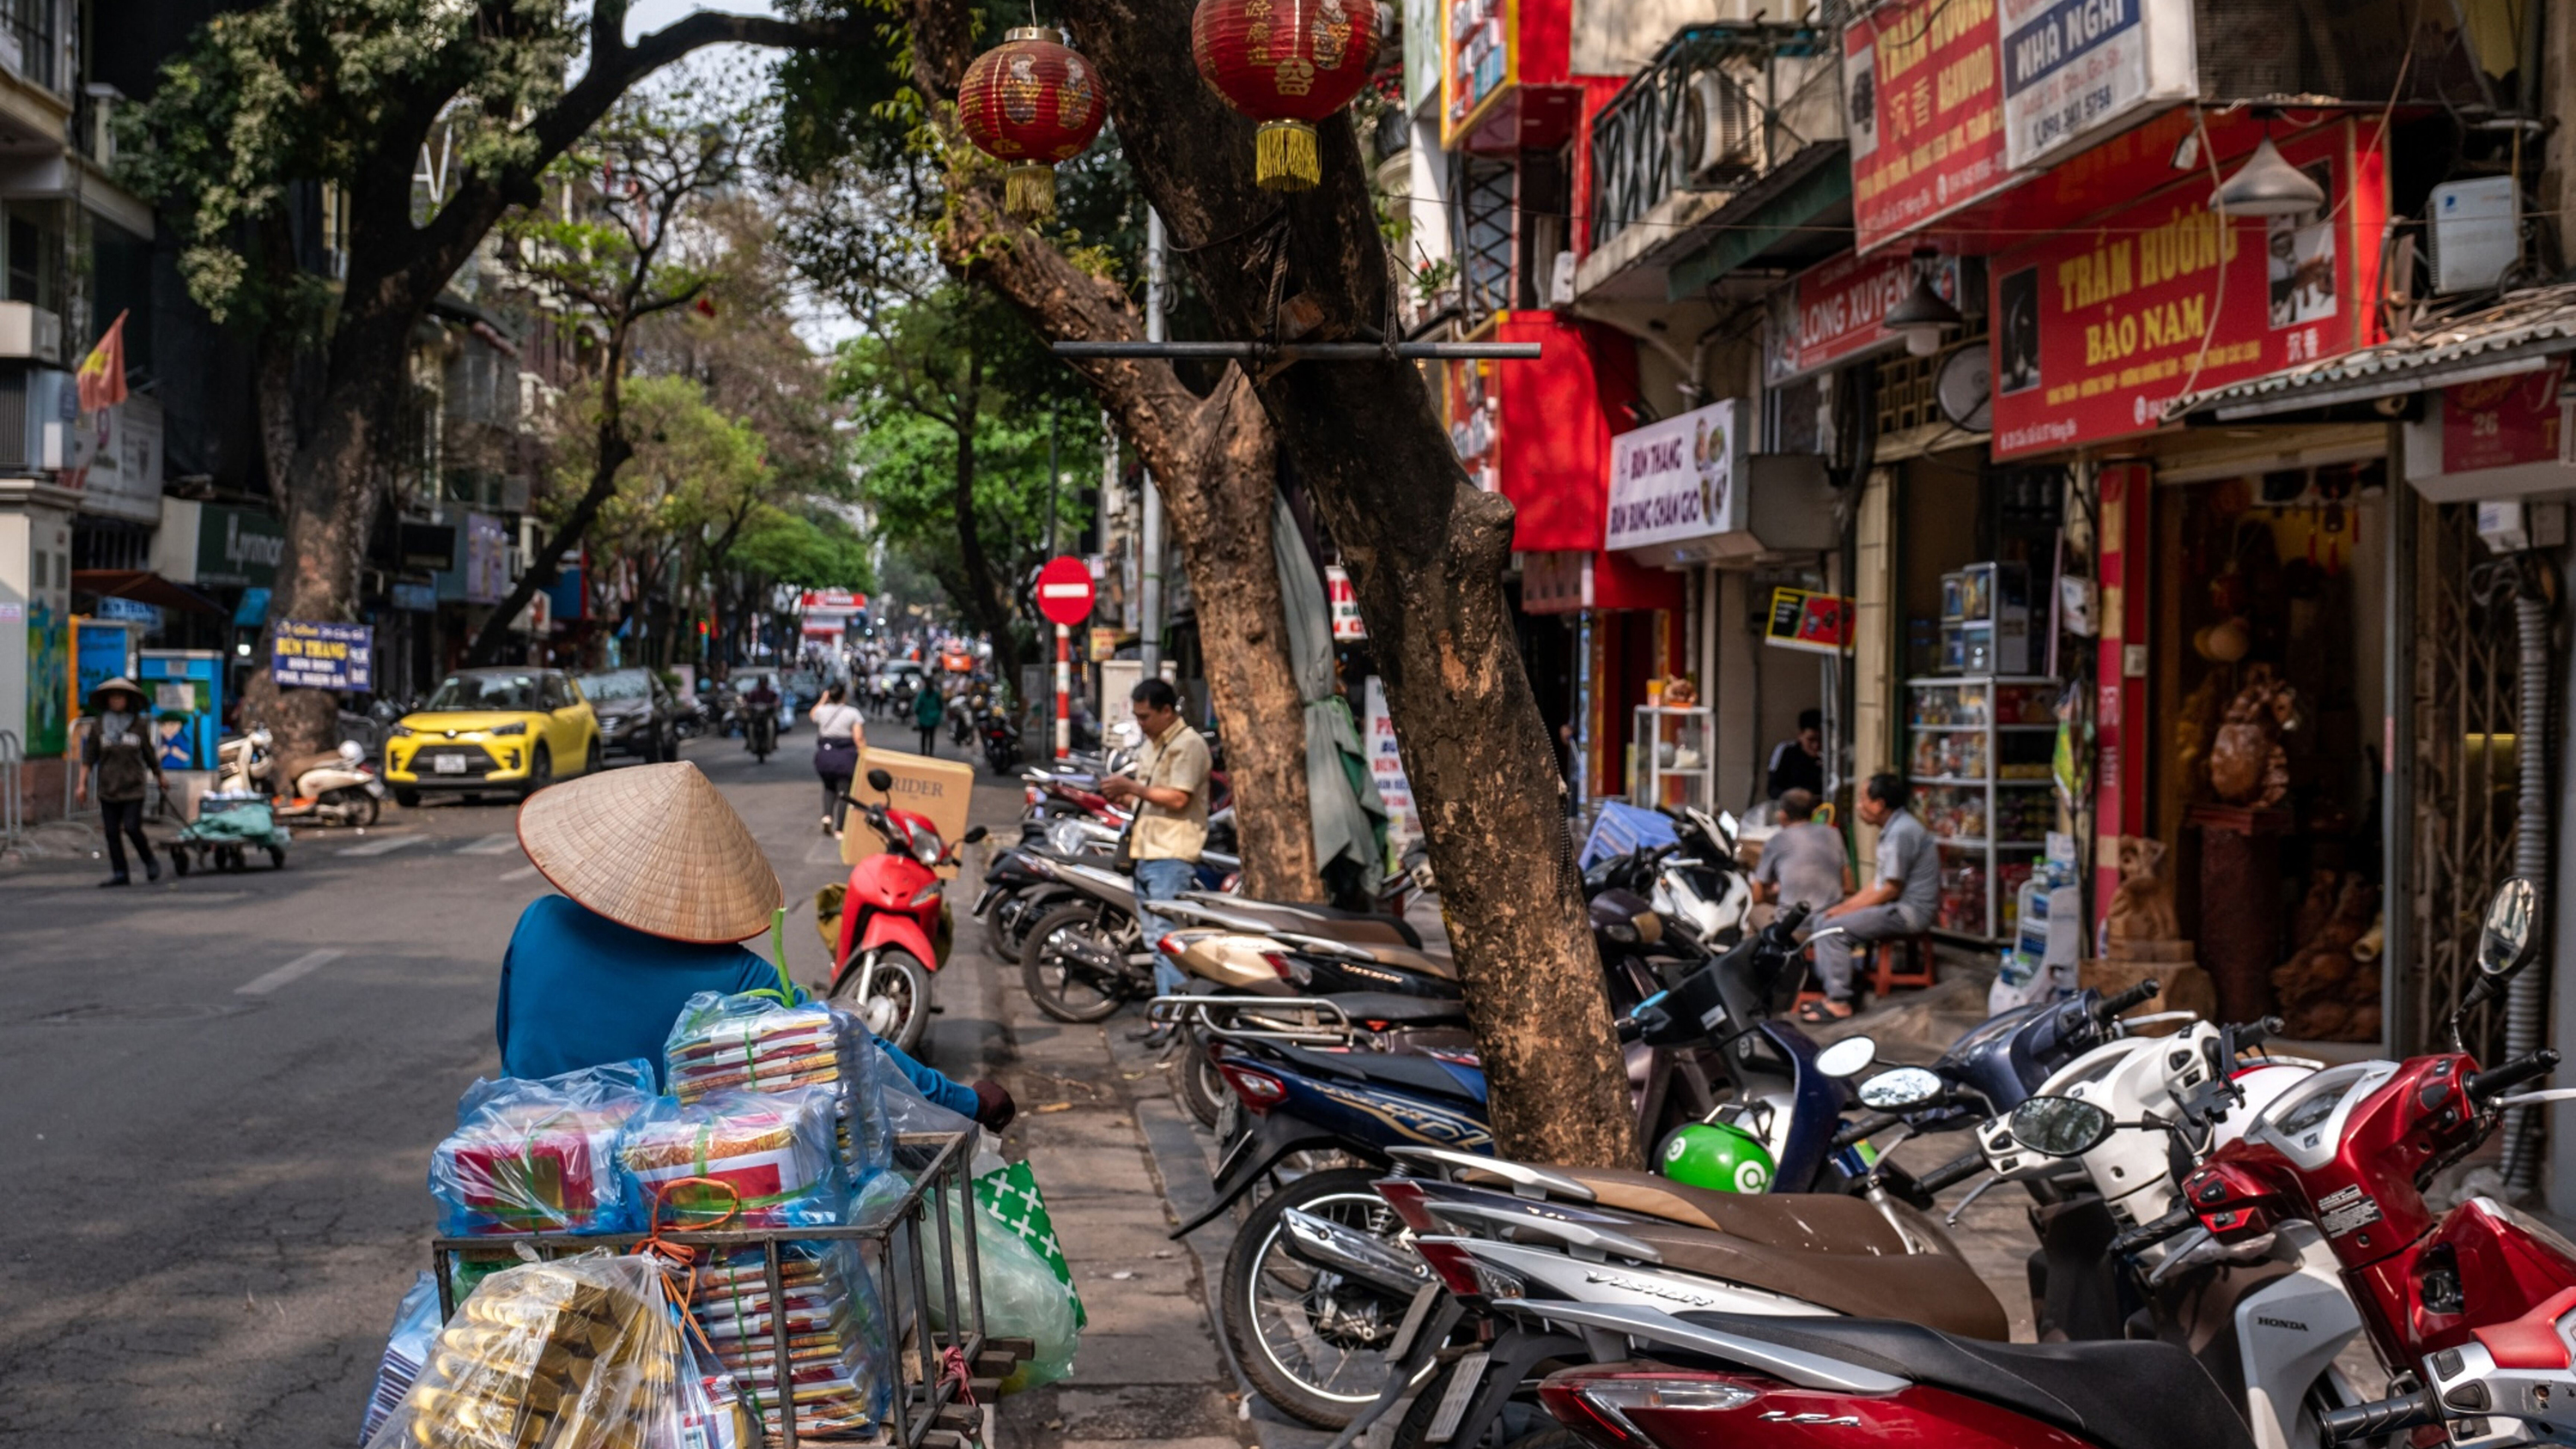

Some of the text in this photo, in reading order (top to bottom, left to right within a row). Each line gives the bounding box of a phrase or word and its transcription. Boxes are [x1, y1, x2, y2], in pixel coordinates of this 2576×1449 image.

[1801, 294, 1846, 349] LONG
[2085, 293, 2205, 367] BẢO NAM
[305, 639, 348, 661] THANG
[2256, 1316, 2309, 1332] HONDA
